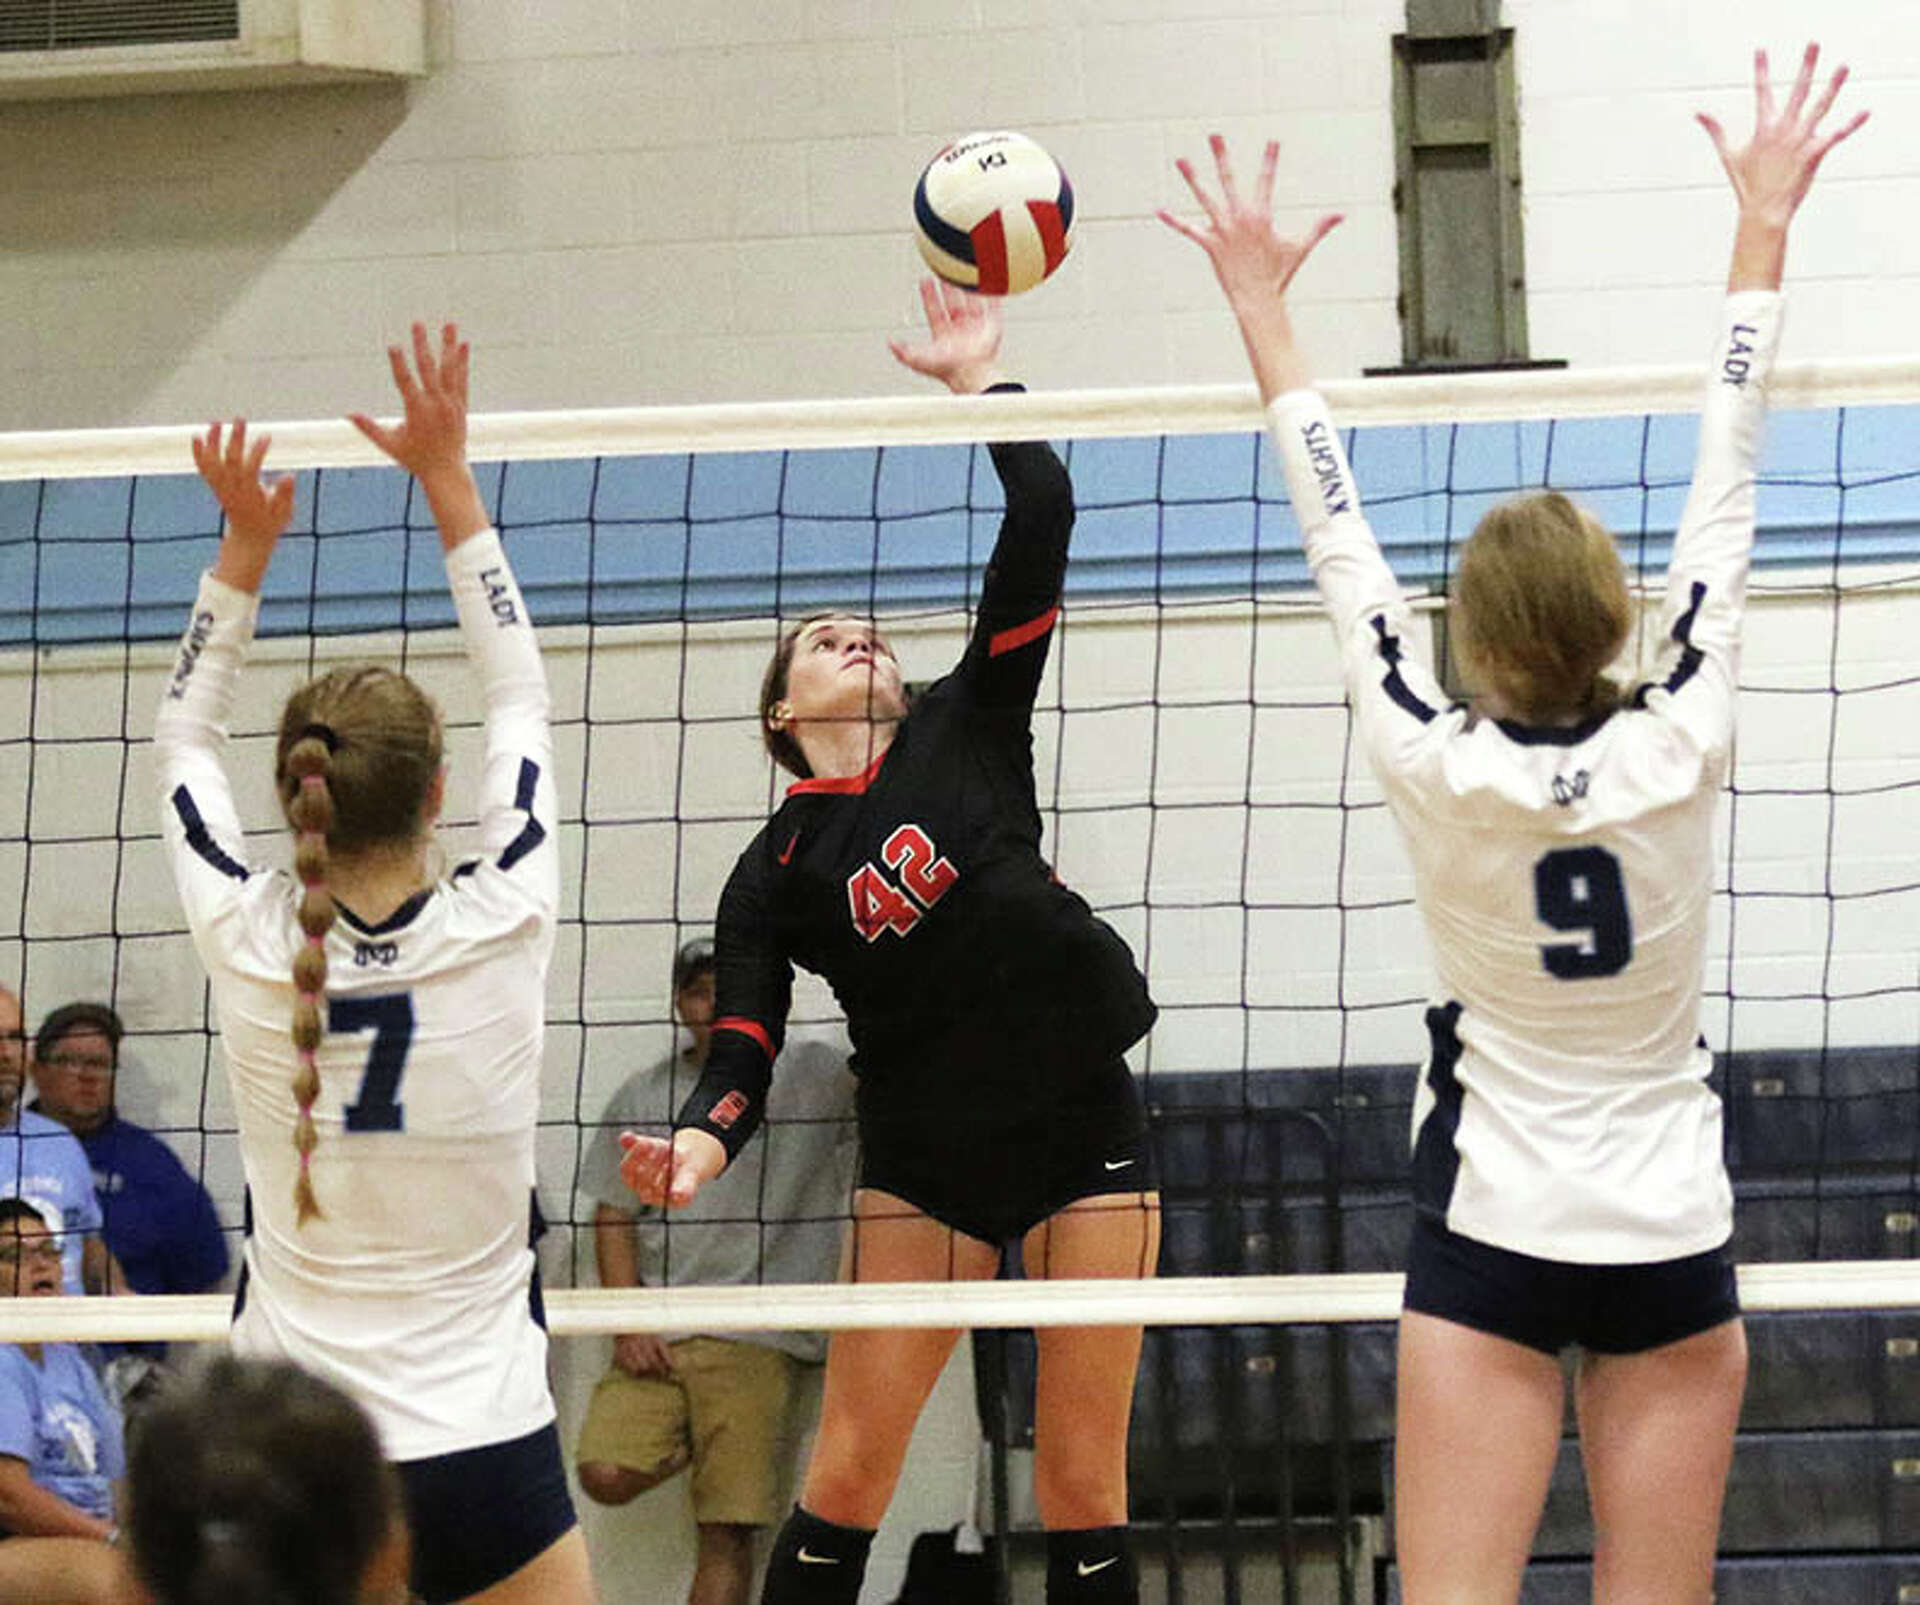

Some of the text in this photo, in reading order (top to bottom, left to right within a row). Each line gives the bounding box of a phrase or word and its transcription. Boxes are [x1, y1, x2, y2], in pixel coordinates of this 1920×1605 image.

[1722, 324, 1757, 390] LADY
[1300, 421, 1351, 516] KNIGHTS
[847, 824, 960, 943] 42
[1534, 845, 1632, 980] 9
[327, 990, 416, 1132] 7
